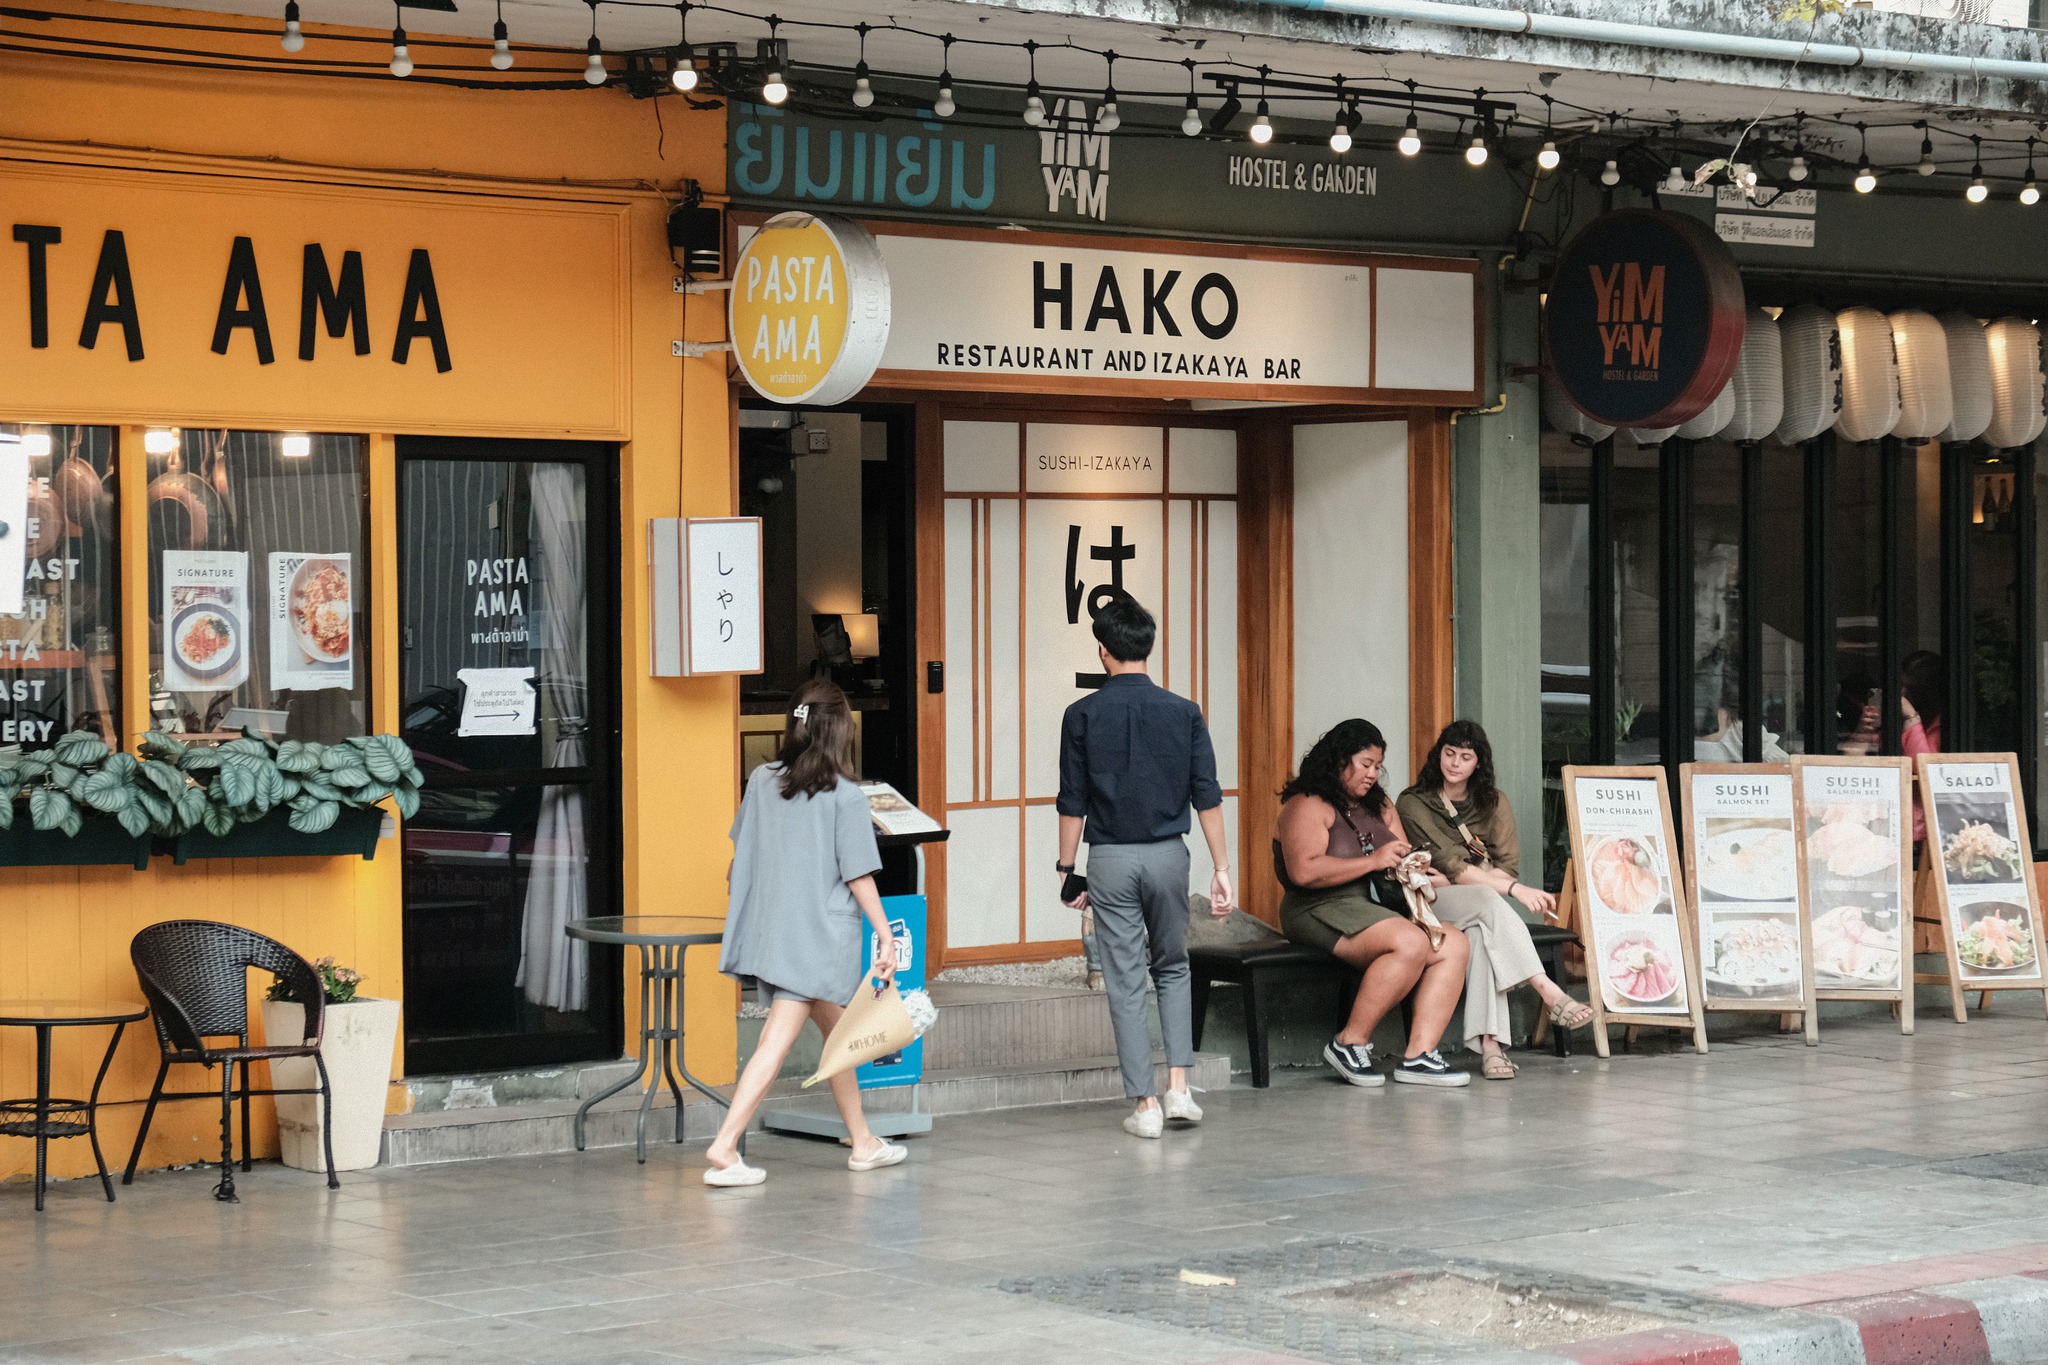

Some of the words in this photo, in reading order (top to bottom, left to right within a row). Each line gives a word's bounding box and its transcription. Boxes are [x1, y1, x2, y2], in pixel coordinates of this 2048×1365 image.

[1229, 155, 1290, 190] HOSTEL
[1293, 163, 1307, 191] &
[1311, 163, 1377, 196] GARDEN
[1042, 166, 1109, 221] YAM
[747, 255, 834, 304] PASTA
[13, 224, 145, 362] TA
[211, 236, 452, 373] AMA
[1032, 261, 1239, 340] HAKO
[752, 314, 821, 365] AMA
[1599, 324, 1662, 370] YAM
[937, 342, 1093, 370] RESTAURANT
[1103, 350, 1147, 372] AND
[1153, 352, 1248, 378] IZAKAYA
[1264, 357, 1301, 380] BAR
[1038, 455, 1153, 471] SUSHI-IZAKAYA
[177, 568, 235, 578] SIGNATURE
[467, 557, 529, 586] PASTA
[474, 589, 523, 618] AMA
[716, 551, 735, 643] しゃり
[1595, 788, 1642, 801] SUSHI
[1715, 785, 1769, 796] SUSHI
[1826, 776, 1880, 788] SUSHI
[1946, 776, 1995, 787] SALAD
[1585, 807, 1653, 816] DON-CHIRASHI
